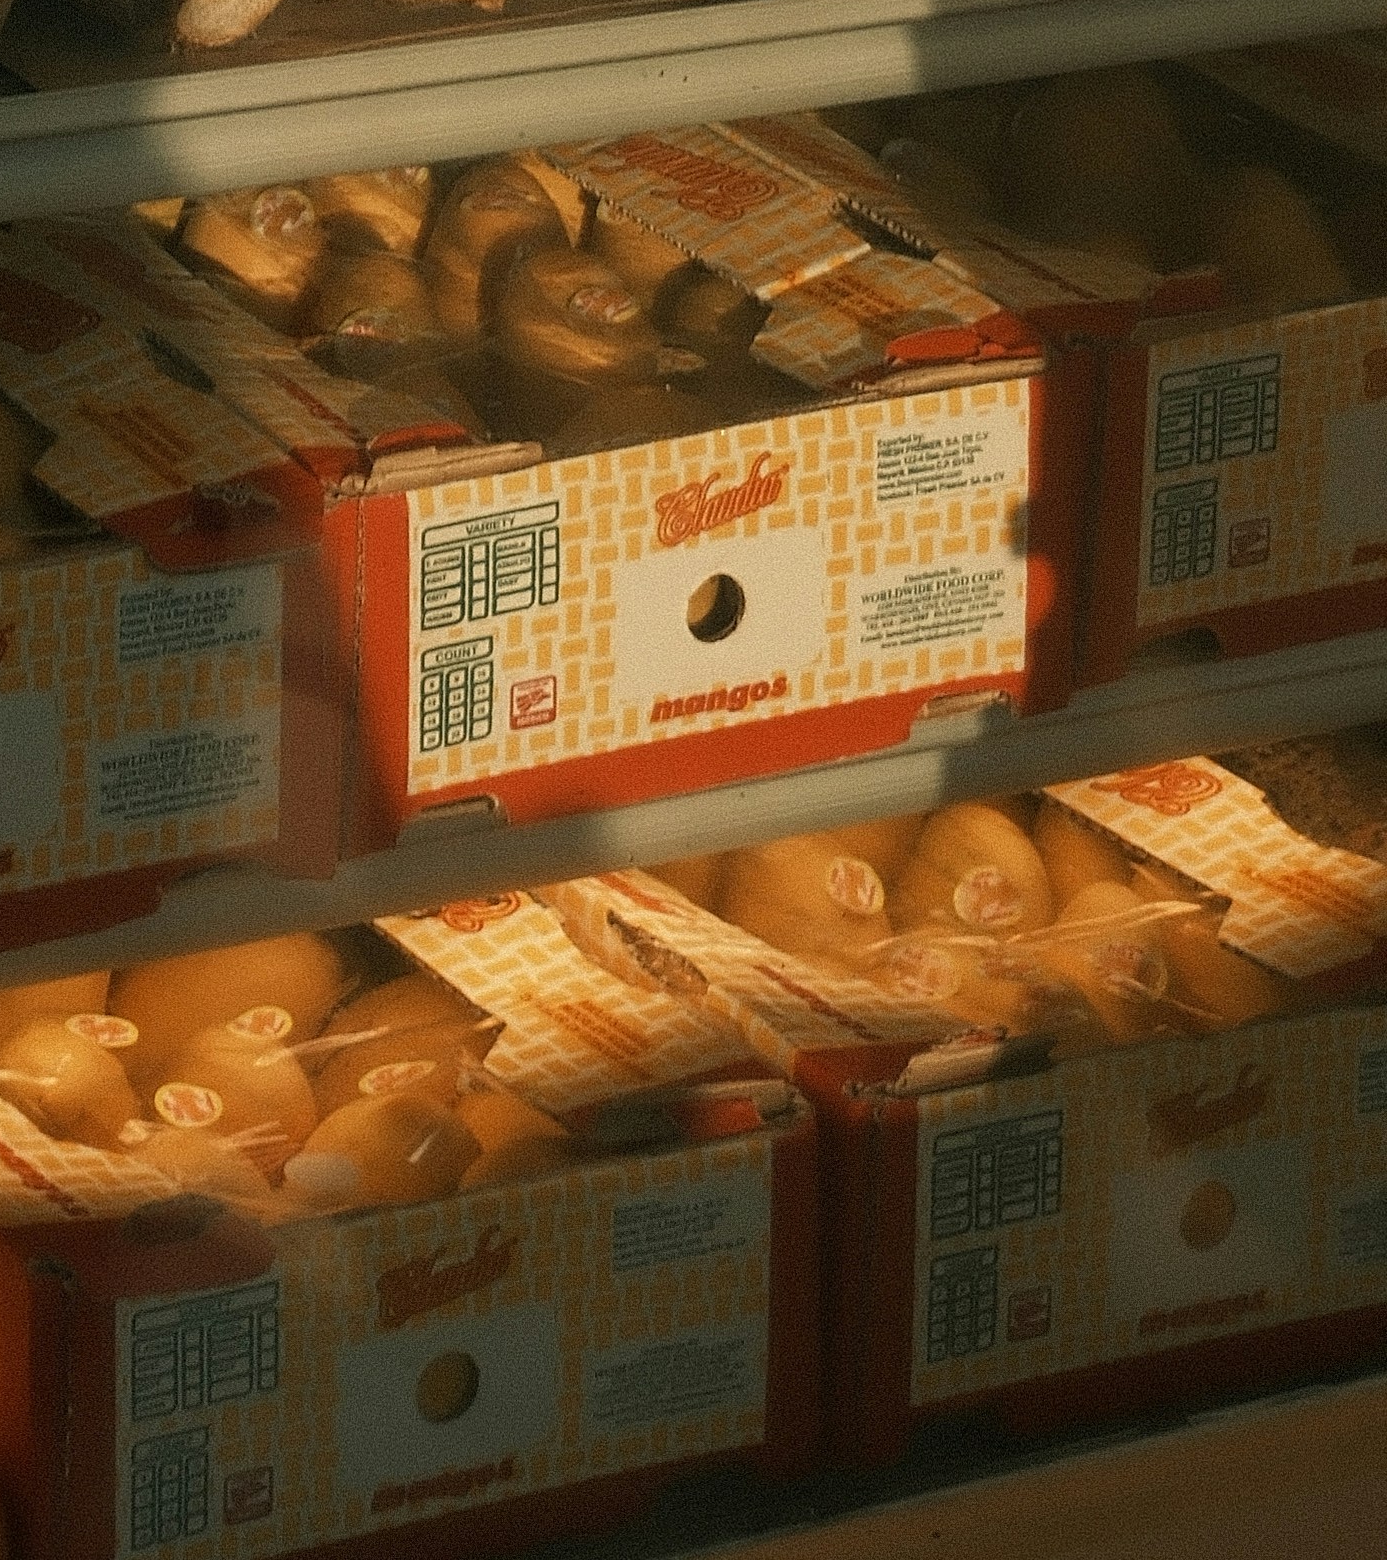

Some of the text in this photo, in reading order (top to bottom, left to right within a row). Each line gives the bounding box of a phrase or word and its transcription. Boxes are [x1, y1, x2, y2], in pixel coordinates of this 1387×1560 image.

[465, 515, 516, 538] VARIETY
[861, 582, 934, 605] WORLDWIDE
[936, 577, 969, 591] FOOD
[435, 645, 478, 662] COUNT
[651, 674, 788, 721] mangos
